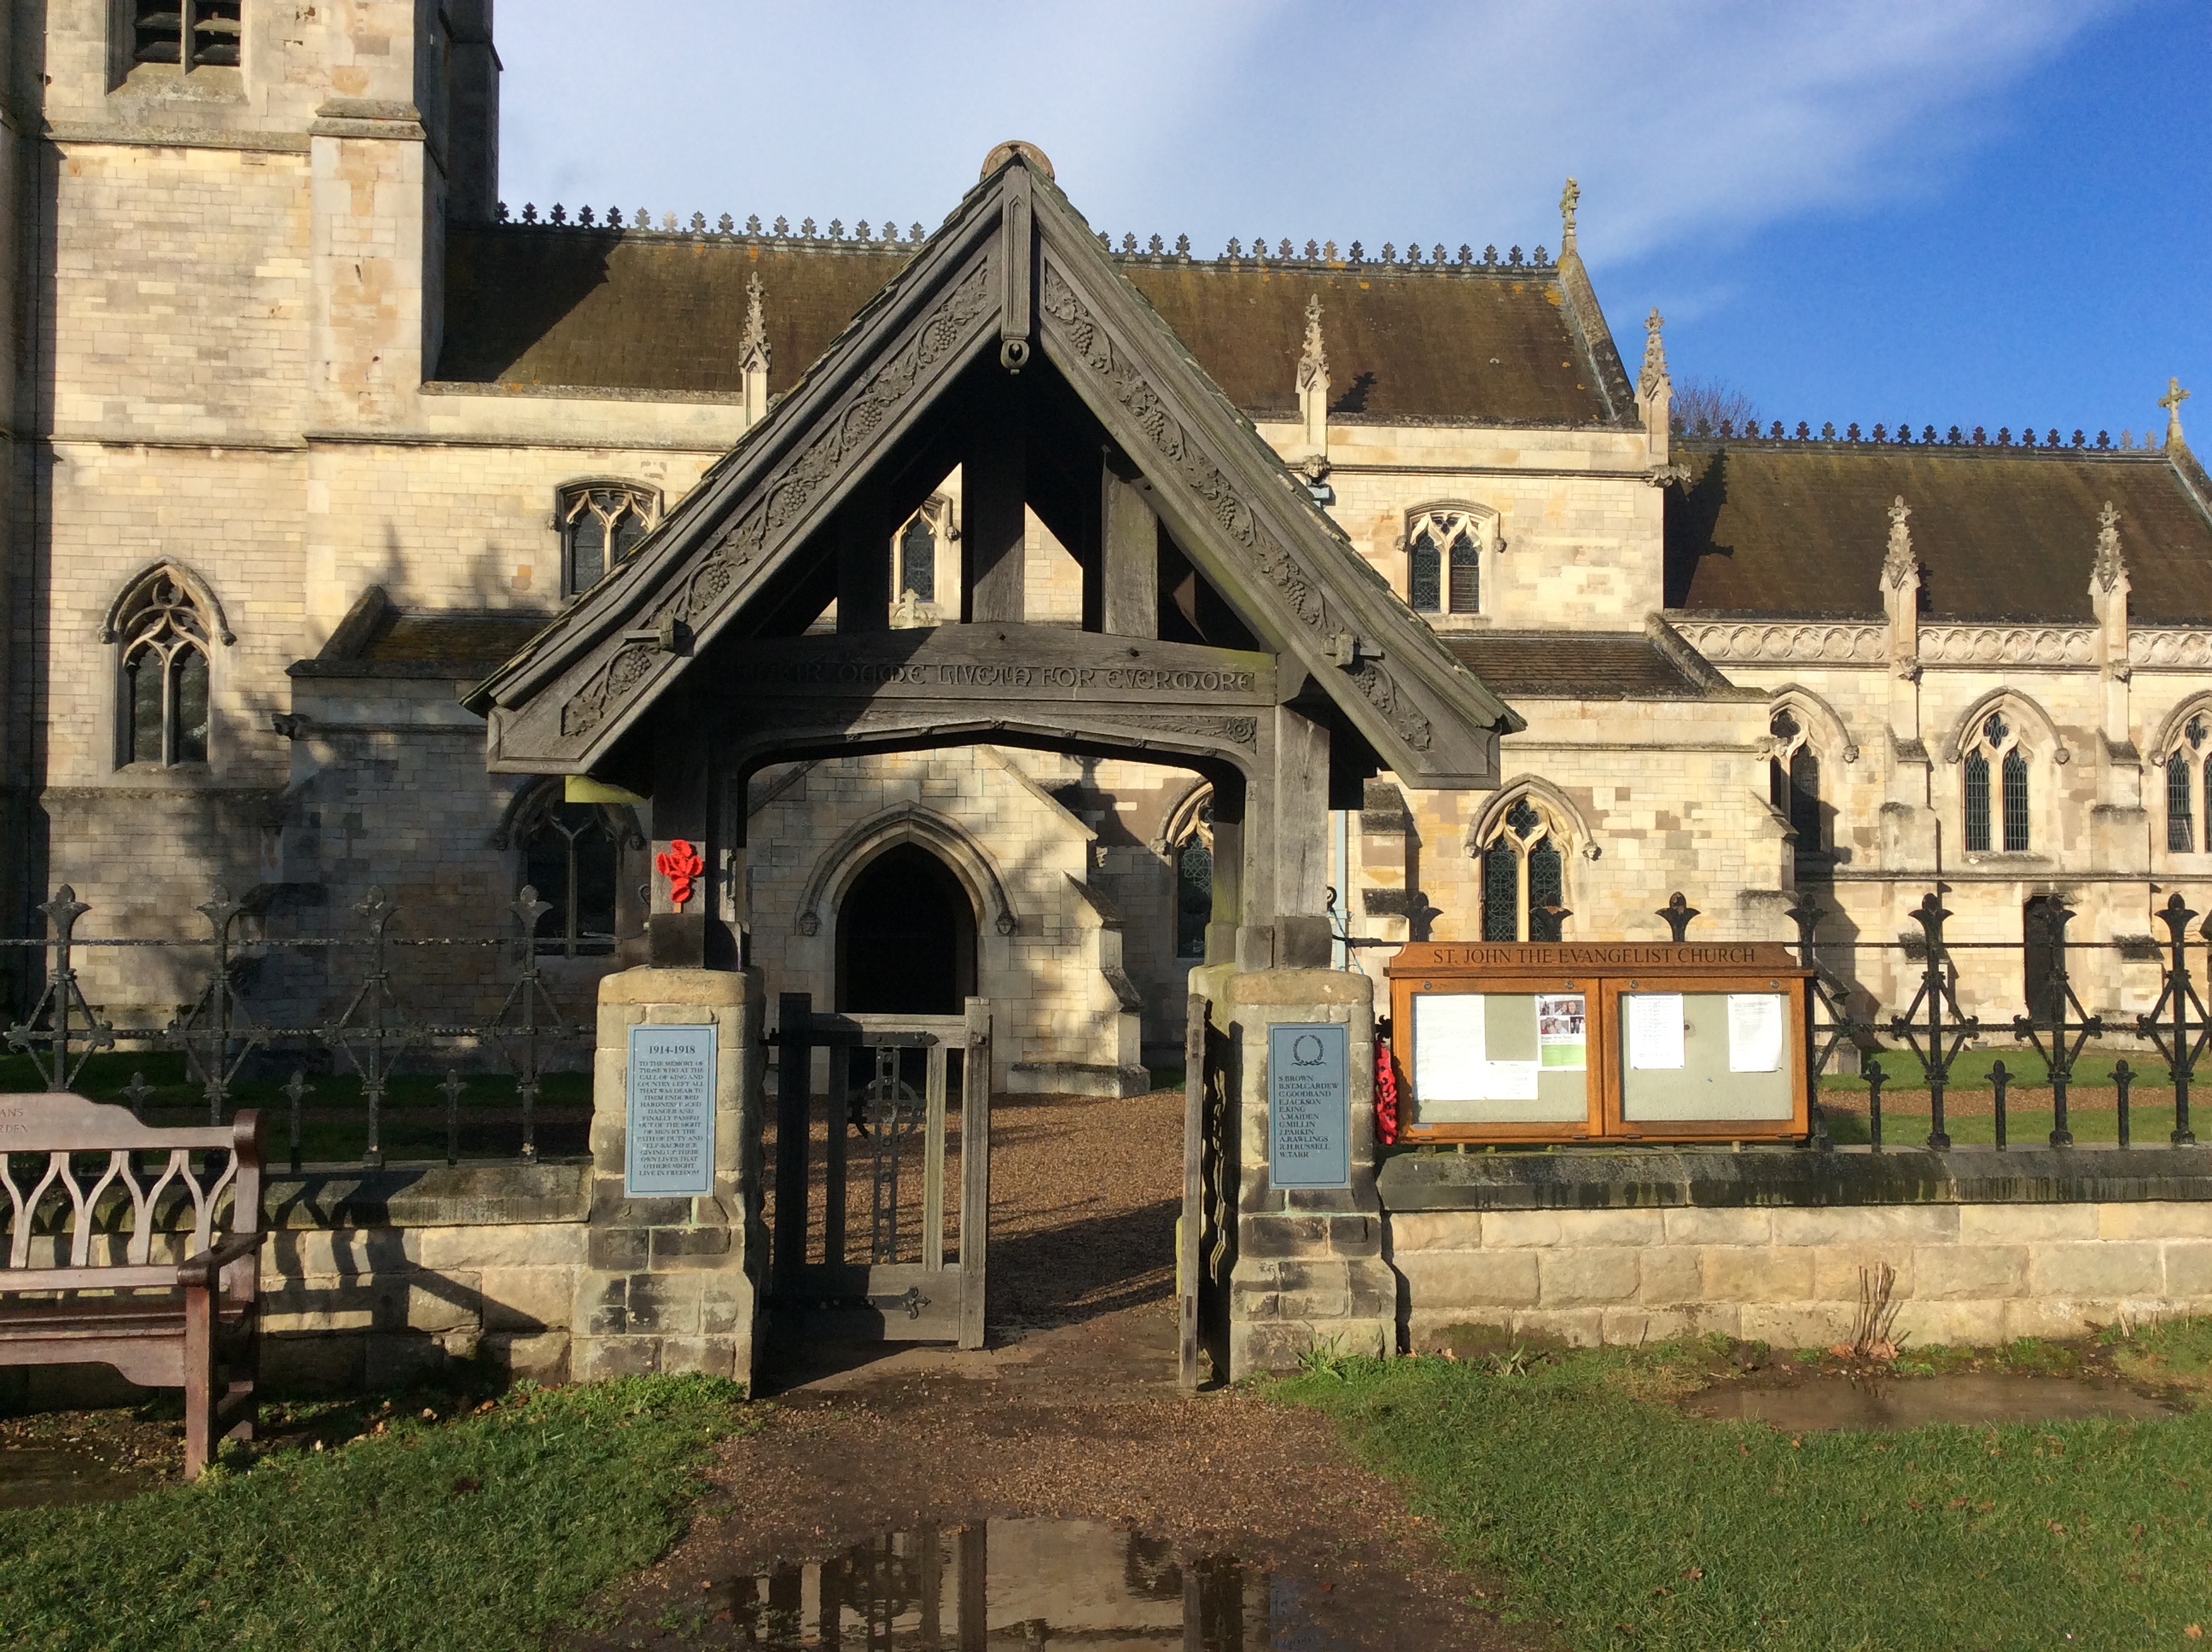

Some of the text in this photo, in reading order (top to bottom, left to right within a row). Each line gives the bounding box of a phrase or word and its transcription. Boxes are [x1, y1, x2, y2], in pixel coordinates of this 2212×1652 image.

[940, 665, 1033, 687] LIVETH
[1040, 666, 1097, 688] FOR
[1106, 668, 1254, 692] EVERMORE
[1434, 949, 1755, 963] ST. JOHN THE EVANGELIST CHURCH
[649, 1045, 696, 1054] 1914-1918
